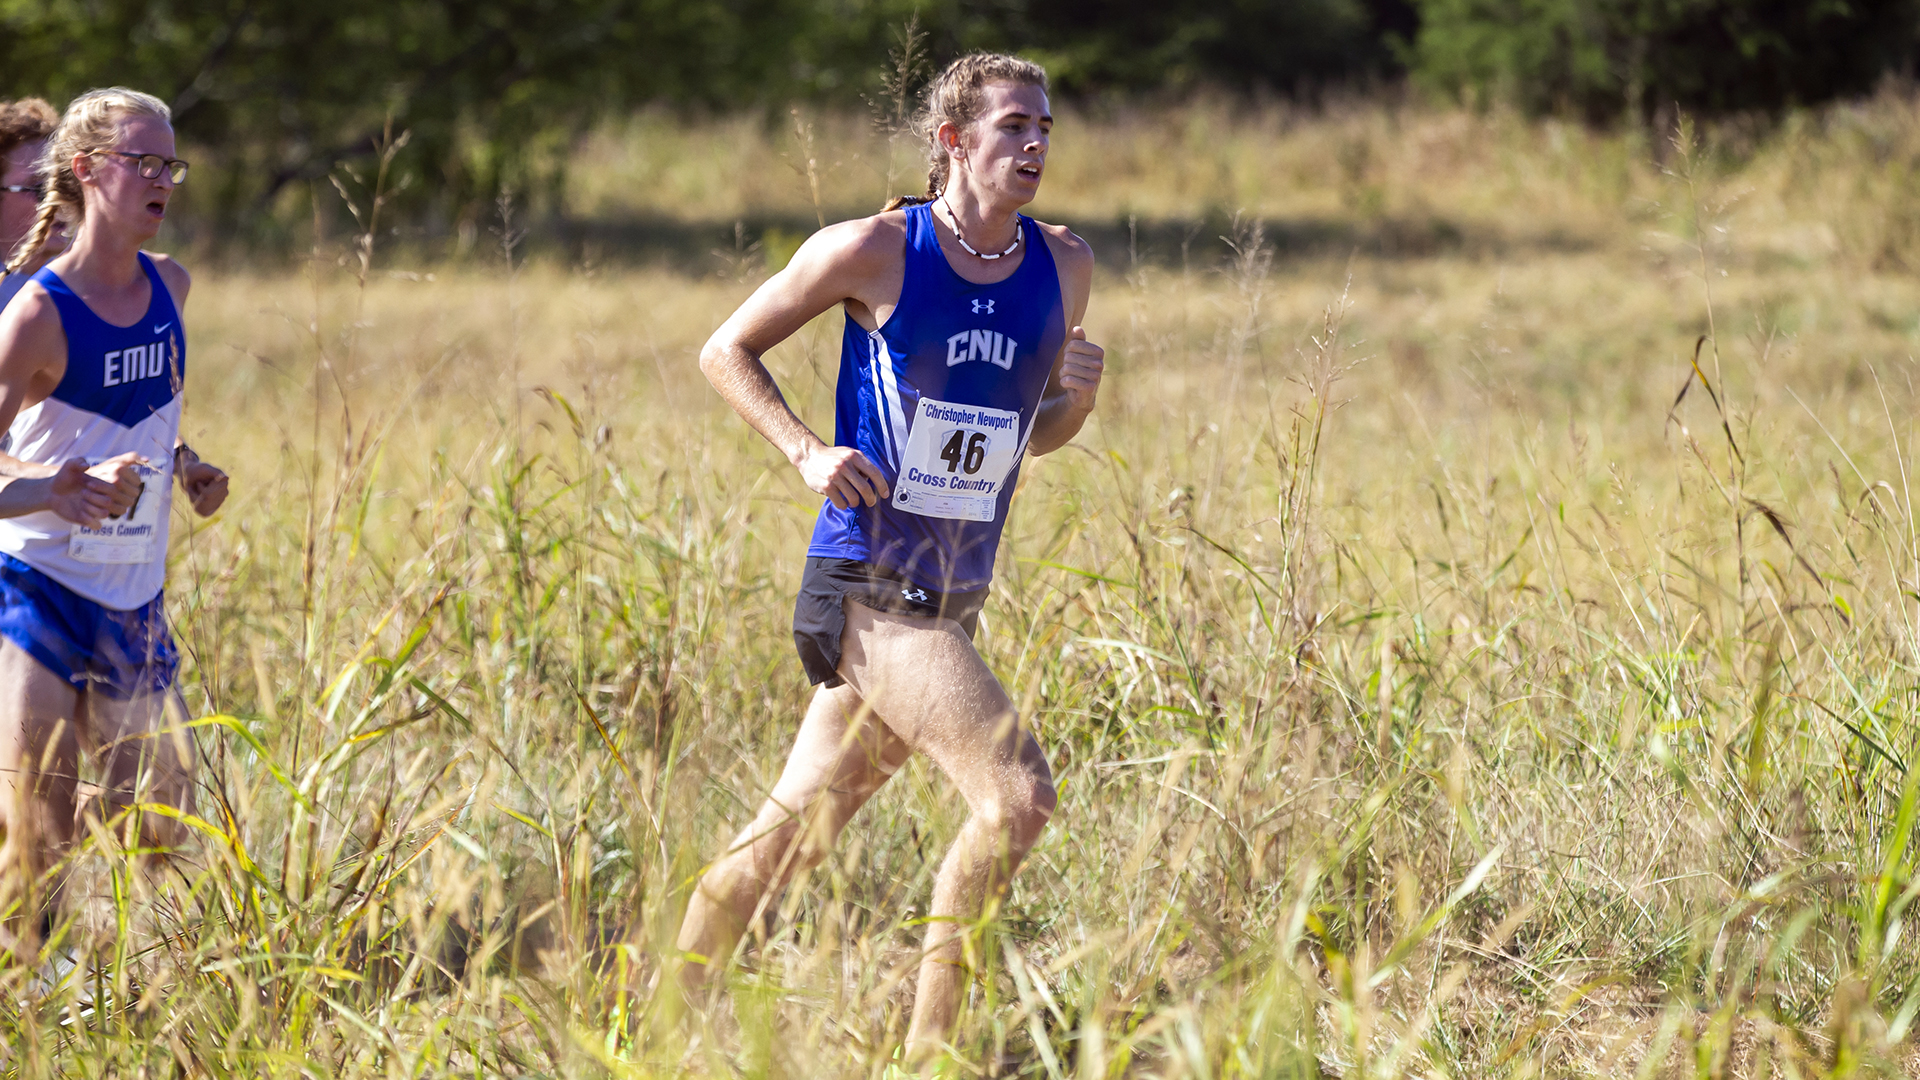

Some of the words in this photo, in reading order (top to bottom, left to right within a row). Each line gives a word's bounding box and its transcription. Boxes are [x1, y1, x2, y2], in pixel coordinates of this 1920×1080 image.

[103, 341, 165, 388] EMU
[946, 329, 1018, 371] CNU
[925, 403, 976, 426] Christopher
[977, 411, 1013, 431] Newport
[940, 429, 987, 475] 46
[908, 467, 947, 488] Cross
[949, 475, 996, 494] Country
[116, 523, 152, 538] Country
